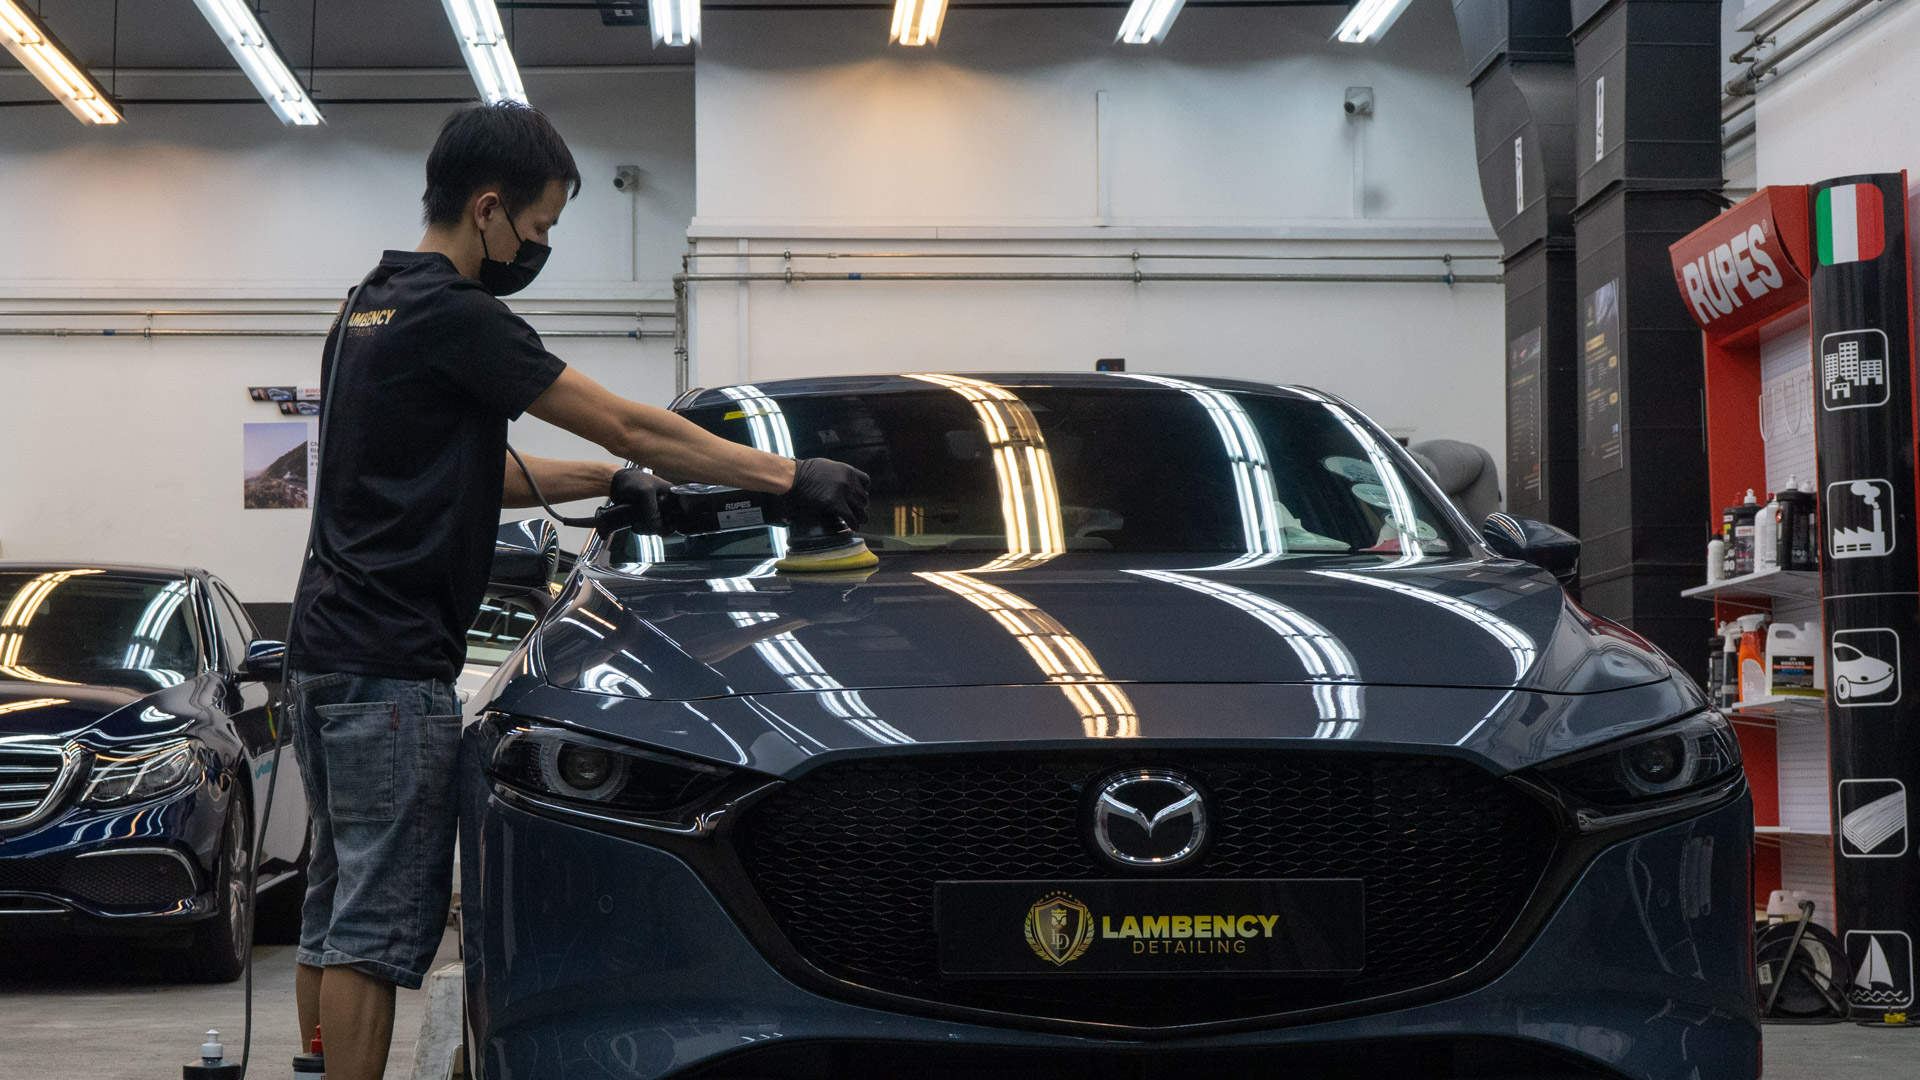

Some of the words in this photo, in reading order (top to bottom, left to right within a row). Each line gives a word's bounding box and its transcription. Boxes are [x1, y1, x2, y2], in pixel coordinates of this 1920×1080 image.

[1682, 223, 1783, 325] RUPES
[341, 309, 397, 327] AMBENCY
[725, 500, 752, 511] RUPES
[1102, 915, 1280, 939] LAMBENCY
[1132, 940, 1247, 954] DETAILING
